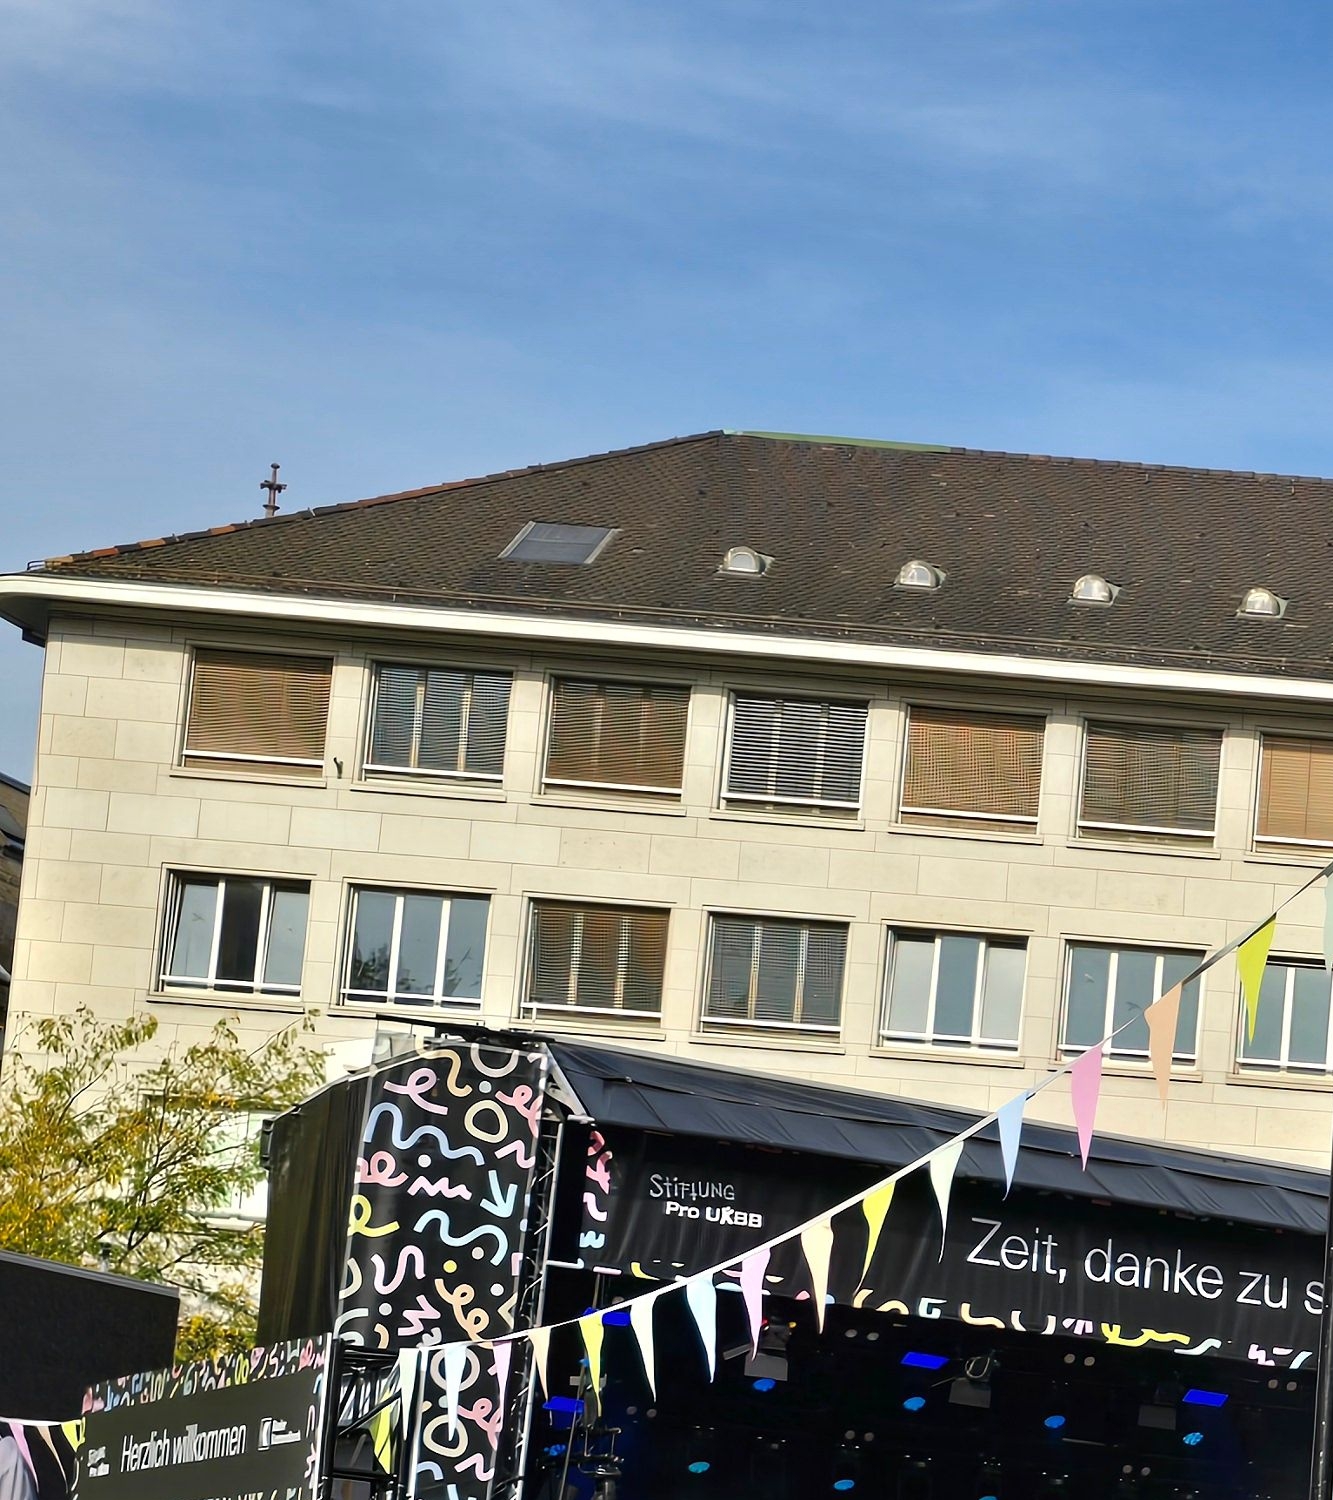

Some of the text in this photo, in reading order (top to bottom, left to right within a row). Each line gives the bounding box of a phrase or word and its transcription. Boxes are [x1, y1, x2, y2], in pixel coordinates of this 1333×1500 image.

[665, 1201, 700, 1219] Pro
[966, 1217, 1067, 1284] Zeit,
[1084, 1238, 1224, 1299] danke
[1236, 1271, 1288, 1310] zu
[120, 1428, 170, 1473] Herzlich
[172, 1423, 247, 1465] willkommen
